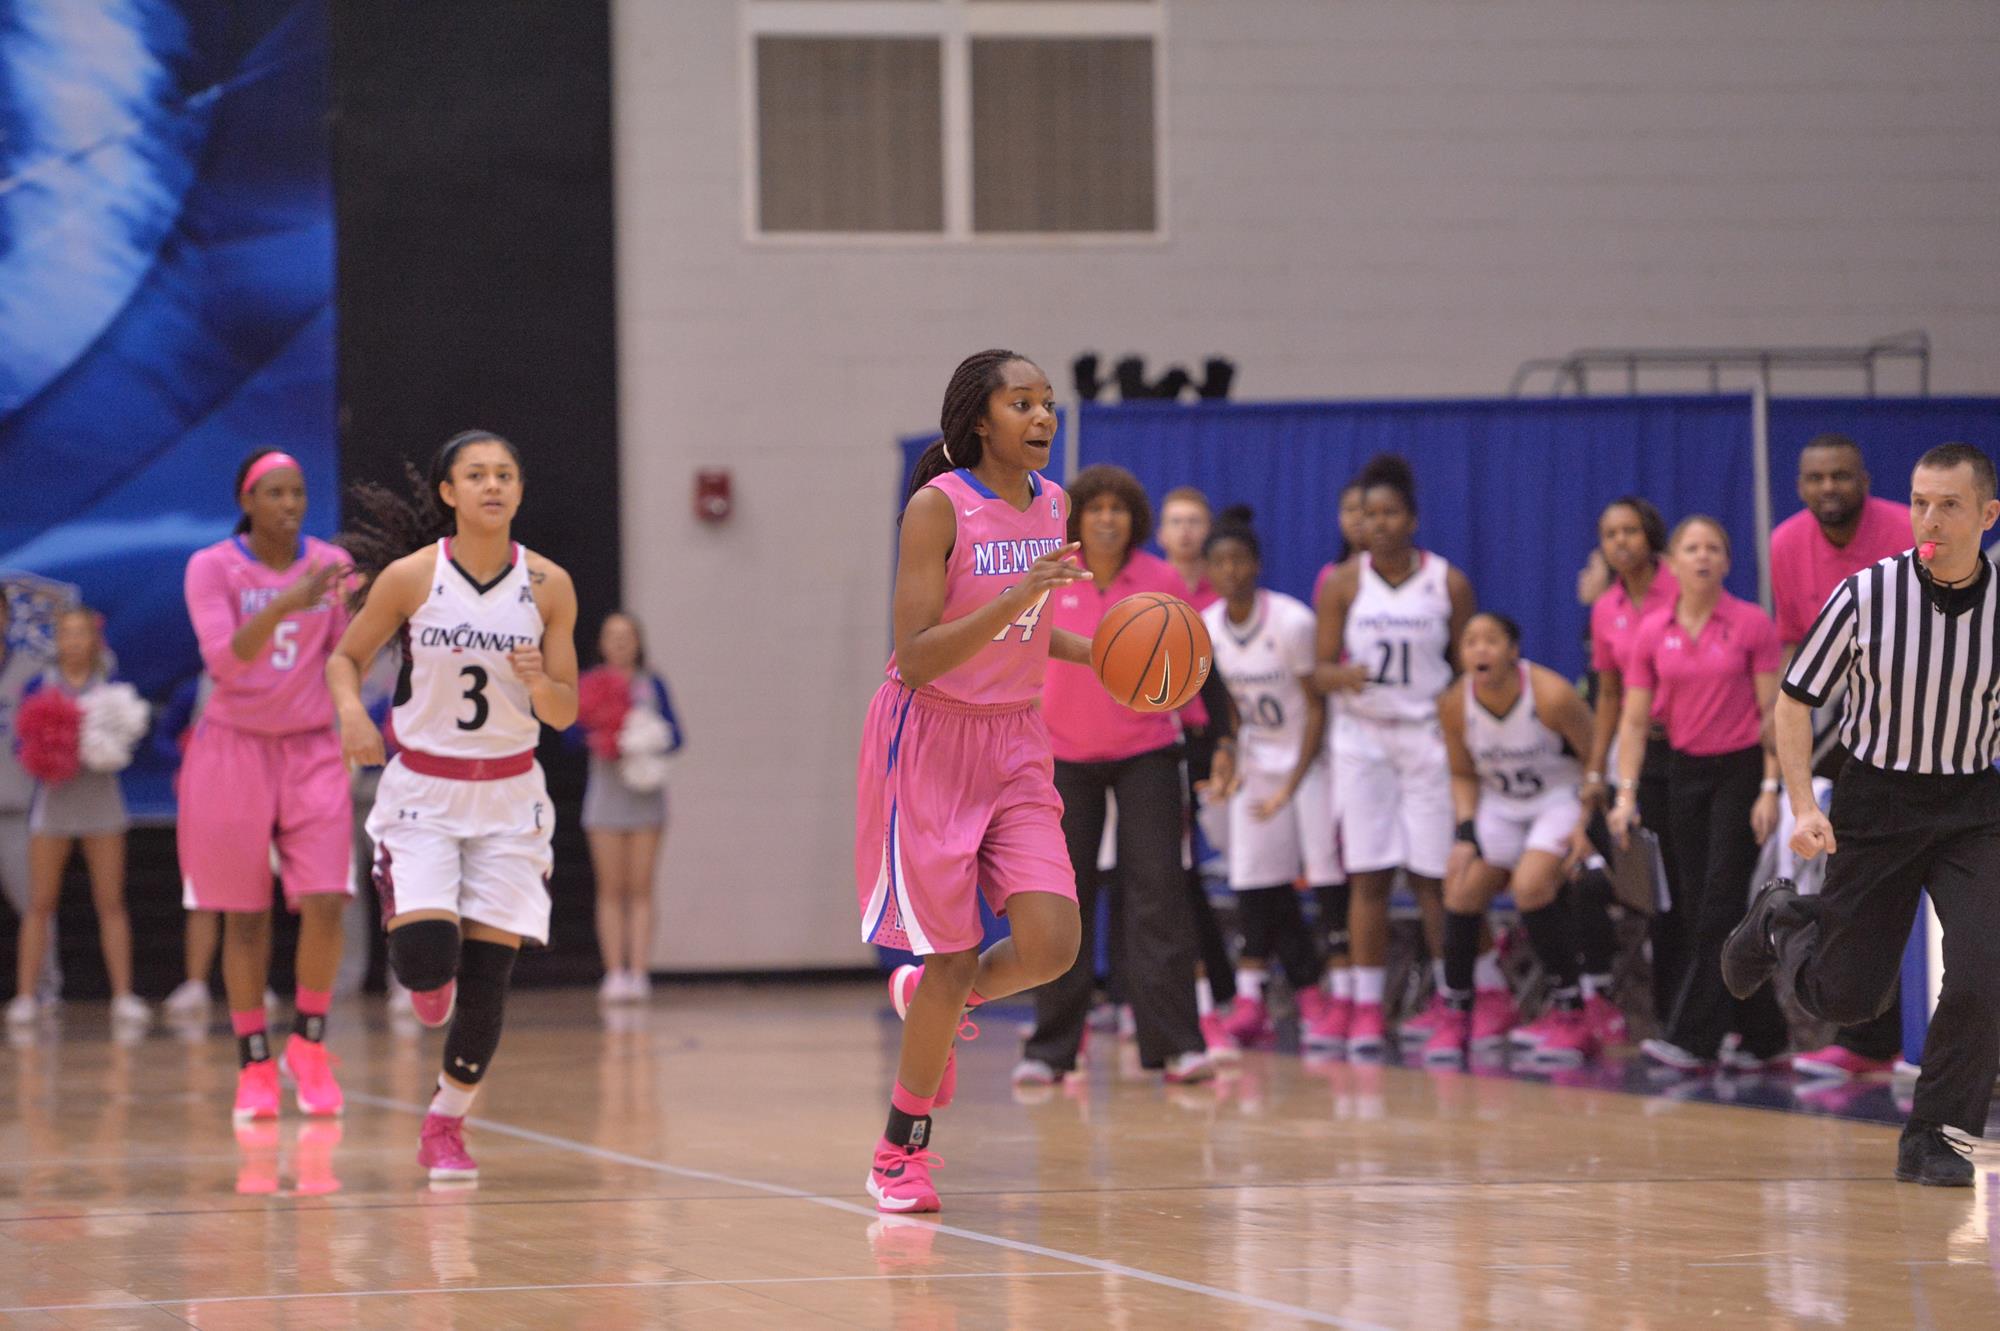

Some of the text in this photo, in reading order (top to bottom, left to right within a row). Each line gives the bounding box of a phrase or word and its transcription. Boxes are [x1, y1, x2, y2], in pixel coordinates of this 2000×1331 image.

[272, 621, 299, 672] 5
[1372, 639, 1410, 685] 21
[457, 665, 489, 731] 3
